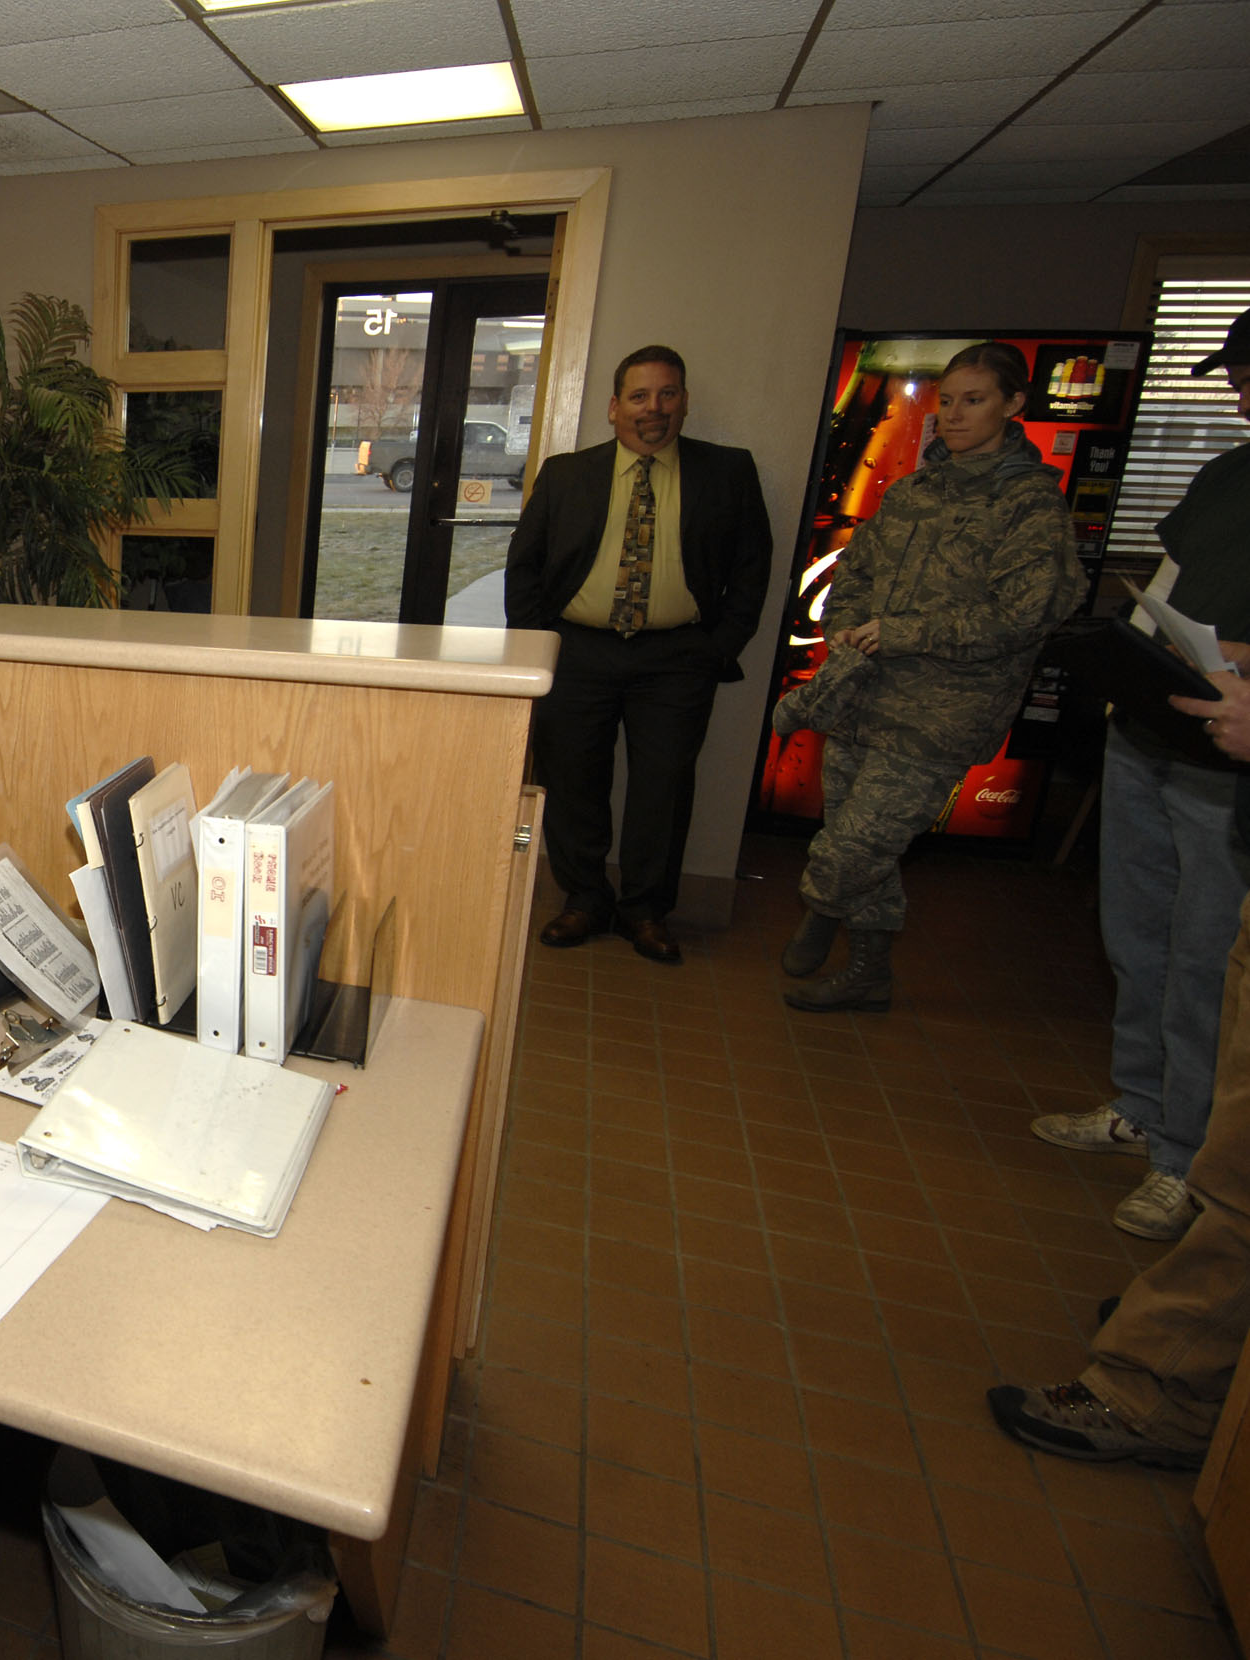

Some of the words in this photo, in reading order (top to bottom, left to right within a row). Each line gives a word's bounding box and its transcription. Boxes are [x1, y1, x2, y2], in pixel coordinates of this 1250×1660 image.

[1090, 446, 1116, 460] Thank
[1090, 461, 1110, 473] You!
[170, 881, 186, 911] VC
